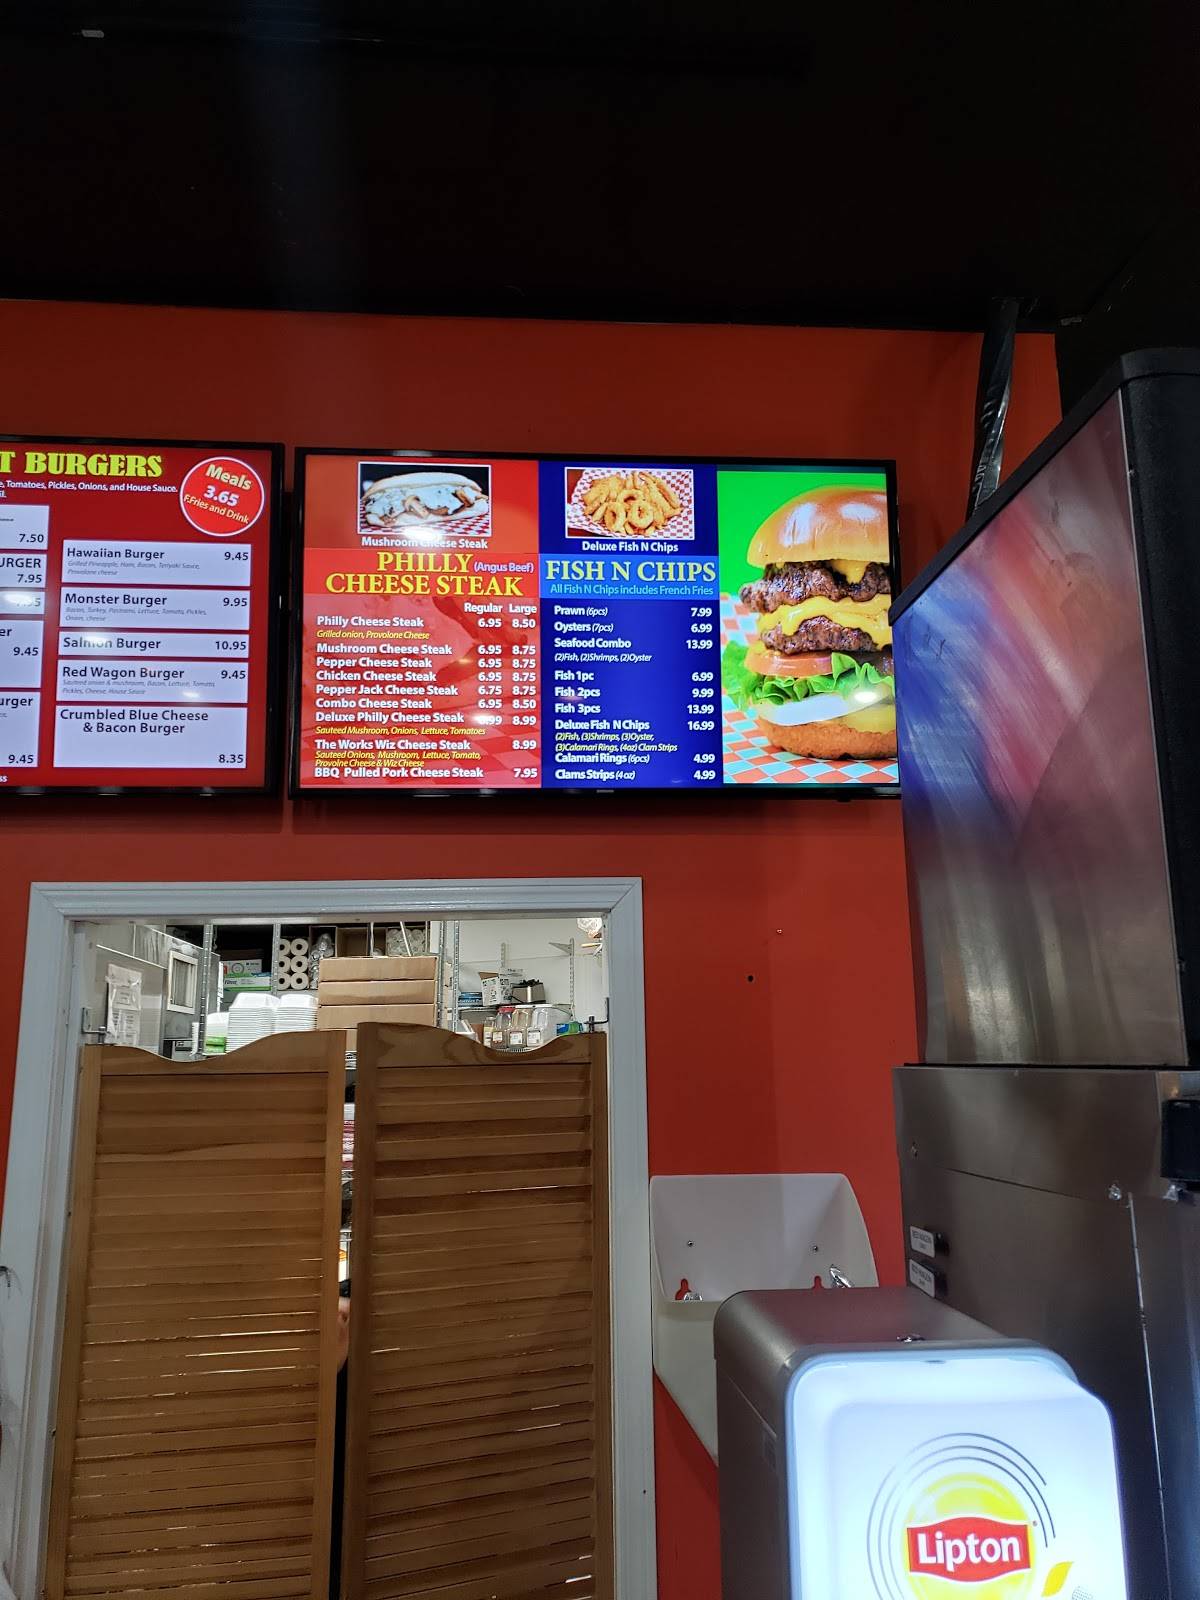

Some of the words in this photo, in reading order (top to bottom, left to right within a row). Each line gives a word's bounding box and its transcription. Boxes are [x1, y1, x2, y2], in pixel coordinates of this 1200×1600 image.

[24, 452, 163, 477] BURGERS
[205, 463, 252, 490] Meals
[6, 480, 47, 489] Tomatoes,
[48, 481, 77, 490] Pickles,
[78, 482, 108, 491] Onions,
[109, 483, 125, 491] and
[126, 483, 151, 492] House
[152, 484, 178, 493] Sauce.
[203, 485, 239, 507] 3.65
[183, 494, 208, 510] F.Fries
[209, 504, 227, 516] and
[226, 509, 250, 524] Drink
[19, 533, 44, 543] 7.50
[361, 536, 418, 547] Mushroom
[458, 538, 488, 549] Steak
[67, 547, 121, 558] Hawaiian
[125, 549, 165, 561] Burger
[224, 551, 249, 561] 9.45
[582, 541, 617, 551] Deluxe
[618, 541, 639, 551] Fish
[640, 542, 649, 551] N
[650, 542, 679, 554] Chips
[377, 551, 474, 573] PHILLY
[474, 561, 508, 573] (Angus
[509, 562, 534, 574] Beef)
[545, 560, 605, 581] FISH
[611, 561, 631, 581] N
[637, 561, 716, 582] CHIPS
[17, 573, 42, 584] 7.95
[326, 572, 431, 594] CHEESE
[436, 575, 524, 596] STEAK
[550, 584, 563, 594] All
[564, 584, 582, 594] Fish
[584, 585, 592, 594] N
[593, 585, 620, 596] Chips
[620, 585, 658, 595] includes
[659, 585, 691, 595] French
[692, 586, 714, 596] Fries
[65, 593, 119, 604] Monster
[123, 594, 167, 608] Burger
[223, 597, 248, 607] 9.95
[464, 602, 503, 614] Regular
[509, 603, 537, 615] Large
[554, 606, 585, 616] Prawn
[586, 607, 608, 617] (6pcs)
[690, 607, 713, 617] 7.99
[317, 615, 349, 628] Philly
[350, 616, 391, 627] Cheese
[392, 616, 424, 627] Steak
[477, 618, 502, 628] 6.95
[512, 618, 536, 628] 8.50
[554, 622, 591, 634] Oysters
[592, 623, 614, 634] (7pcs)
[690, 623, 713, 633] 6.99
[316, 629, 341, 638] Grilled
[341, 630, 365, 639] onion,
[366, 630, 403, 639] Provolone
[403, 631, 430, 640] Cheese
[116, 637, 161, 651] Burger
[215, 640, 246, 650] 10.95
[316, 642, 377, 653] Mushroom
[379, 643, 419, 654] Cheese
[420, 644, 452, 655] Steak
[477, 645, 502, 655] 6.95
[512, 645, 536, 655] 8.75
[554, 638, 595, 648] Seafood
[595, 638, 631, 649] Combo
[686, 639, 713, 650] 13.99
[13, 646, 39, 656] 9.45
[316, 656, 357, 668] Pepper
[358, 657, 399, 667] Cheese
[400, 657, 432, 668] Steak
[477, 658, 502, 668] 6.95
[512, 659, 536, 668] 8.75
[62, 666, 87, 677] Red
[90, 666, 136, 680] Wagon
[140, 667, 184, 681] Burger
[220, 669, 246, 679] 9.45
[316, 669, 361, 680] Chicken
[362, 670, 403, 681] Cheese
[404, 671, 437, 681] Steak
[478, 672, 502, 681] 6.95
[512, 672, 536, 682] 8.75
[554, 670, 575, 681] Fish
[576, 671, 594, 682] 1pc
[691, 672, 714, 682] 6.99
[316, 684, 357, 696] Pepper
[358, 684, 383, 695] Jack
[384, 685, 425, 695] Cheese
[427, 685, 458, 695] Steak
[478, 685, 502, 695] 6.75
[512, 686, 537, 695] 8.75
[554, 687, 575, 697] Fish
[577, 687, 601, 699] 2pcs
[692, 688, 714, 698] 9.99
[315, 698, 356, 708] Combo
[358, 698, 399, 708] Cheese
[400, 698, 432, 709] Steak
[478, 699, 502, 709] 6.95
[512, 699, 537, 709] 8.50
[555, 703, 575, 713] Fish
[577, 703, 601, 715] 3pcs
[687, 704, 714, 714] 13.99
[60, 708, 125, 720] Crumbled
[129, 709, 158, 720] Blue
[161, 710, 209, 721] Cheese
[315, 711, 355, 722] Deluxe
[357, 711, 390, 724] Philly
[391, 712, 432, 722] Cheese
[433, 712, 464, 723] Steak
[512, 715, 537, 726] 8.99
[83, 722, 93, 733] &
[96, 722, 136, 733] Bacon
[140, 723, 185, 736] Burger
[555, 720, 589, 730] Deluxe
[590, 720, 610, 730] Fish
[612, 721, 622, 730] N
[622, 720, 650, 732] Chips
[687, 720, 715, 730] 16.99
[314, 739, 337, 750] The
[338, 739, 373, 750] Works
[375, 739, 396, 750] Wiz
[397, 740, 437, 750] Cheese
[439, 740, 471, 750] Steak
[512, 740, 537, 750] 8.99
[8, 754, 34, 764] 9.45
[218, 754, 244, 764] 8.35
[555, 752, 600, 763] Calamari
[600, 753, 627, 765] Rings
[628, 754, 650, 764] (6pcs)
[693, 754, 716, 763] 4.99
[314, 767, 340, 778] BBQ
[343, 767, 380, 778] Pulled
[382, 767, 409, 778] Pork
[410, 767, 450, 778] Cheese
[452, 767, 484, 778] Steak
[513, 767, 538, 778] 7.95
[555, 769, 586, 779] Clams
[586, 769, 615, 781] Strips
[693, 770, 716, 780] 4.99
[916, 1531, 1021, 1573] Lipton
